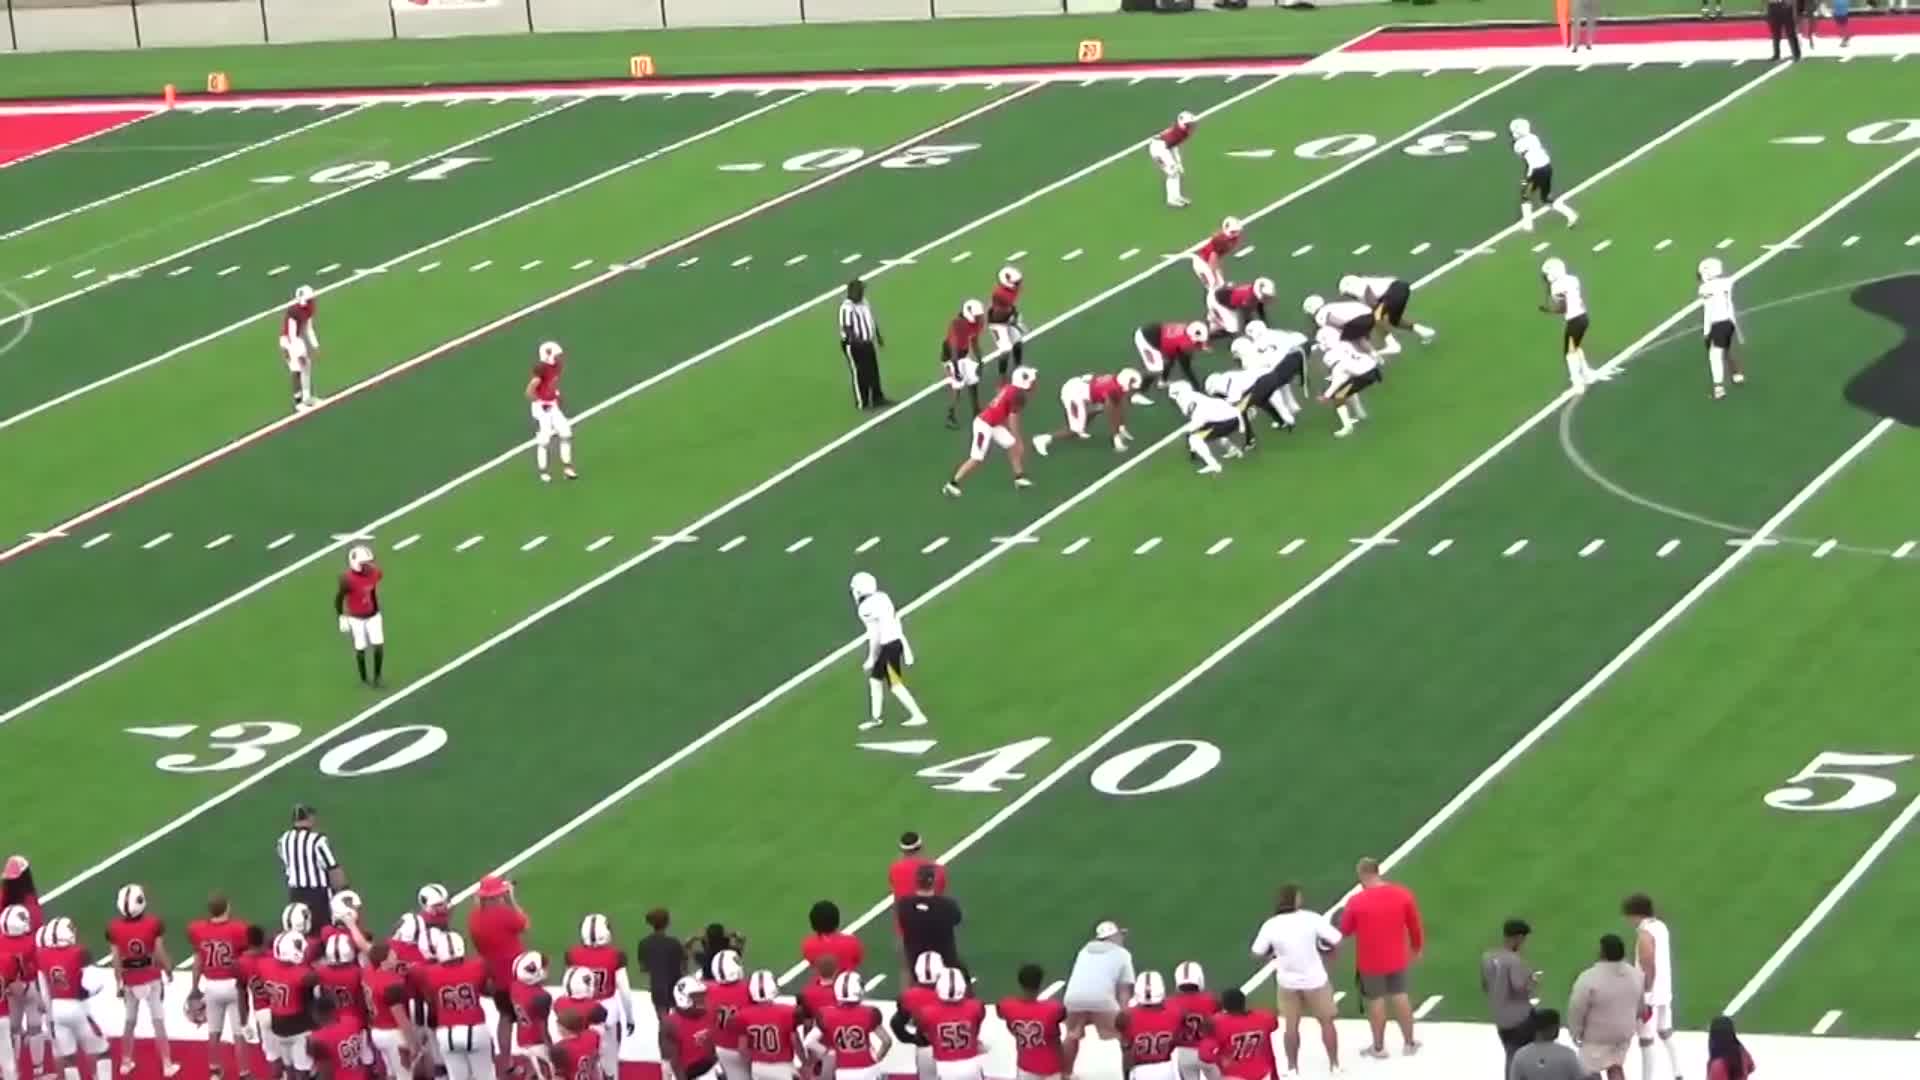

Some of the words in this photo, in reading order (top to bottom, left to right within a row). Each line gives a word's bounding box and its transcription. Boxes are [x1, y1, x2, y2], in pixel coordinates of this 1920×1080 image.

[155, 721, 448, 776] 30
[915, 736, 1222, 794] 40
[1763, 751, 1916, 811] 5
[748, 1025, 780, 1054] 70
[938, 1021, 972, 1050] 55
